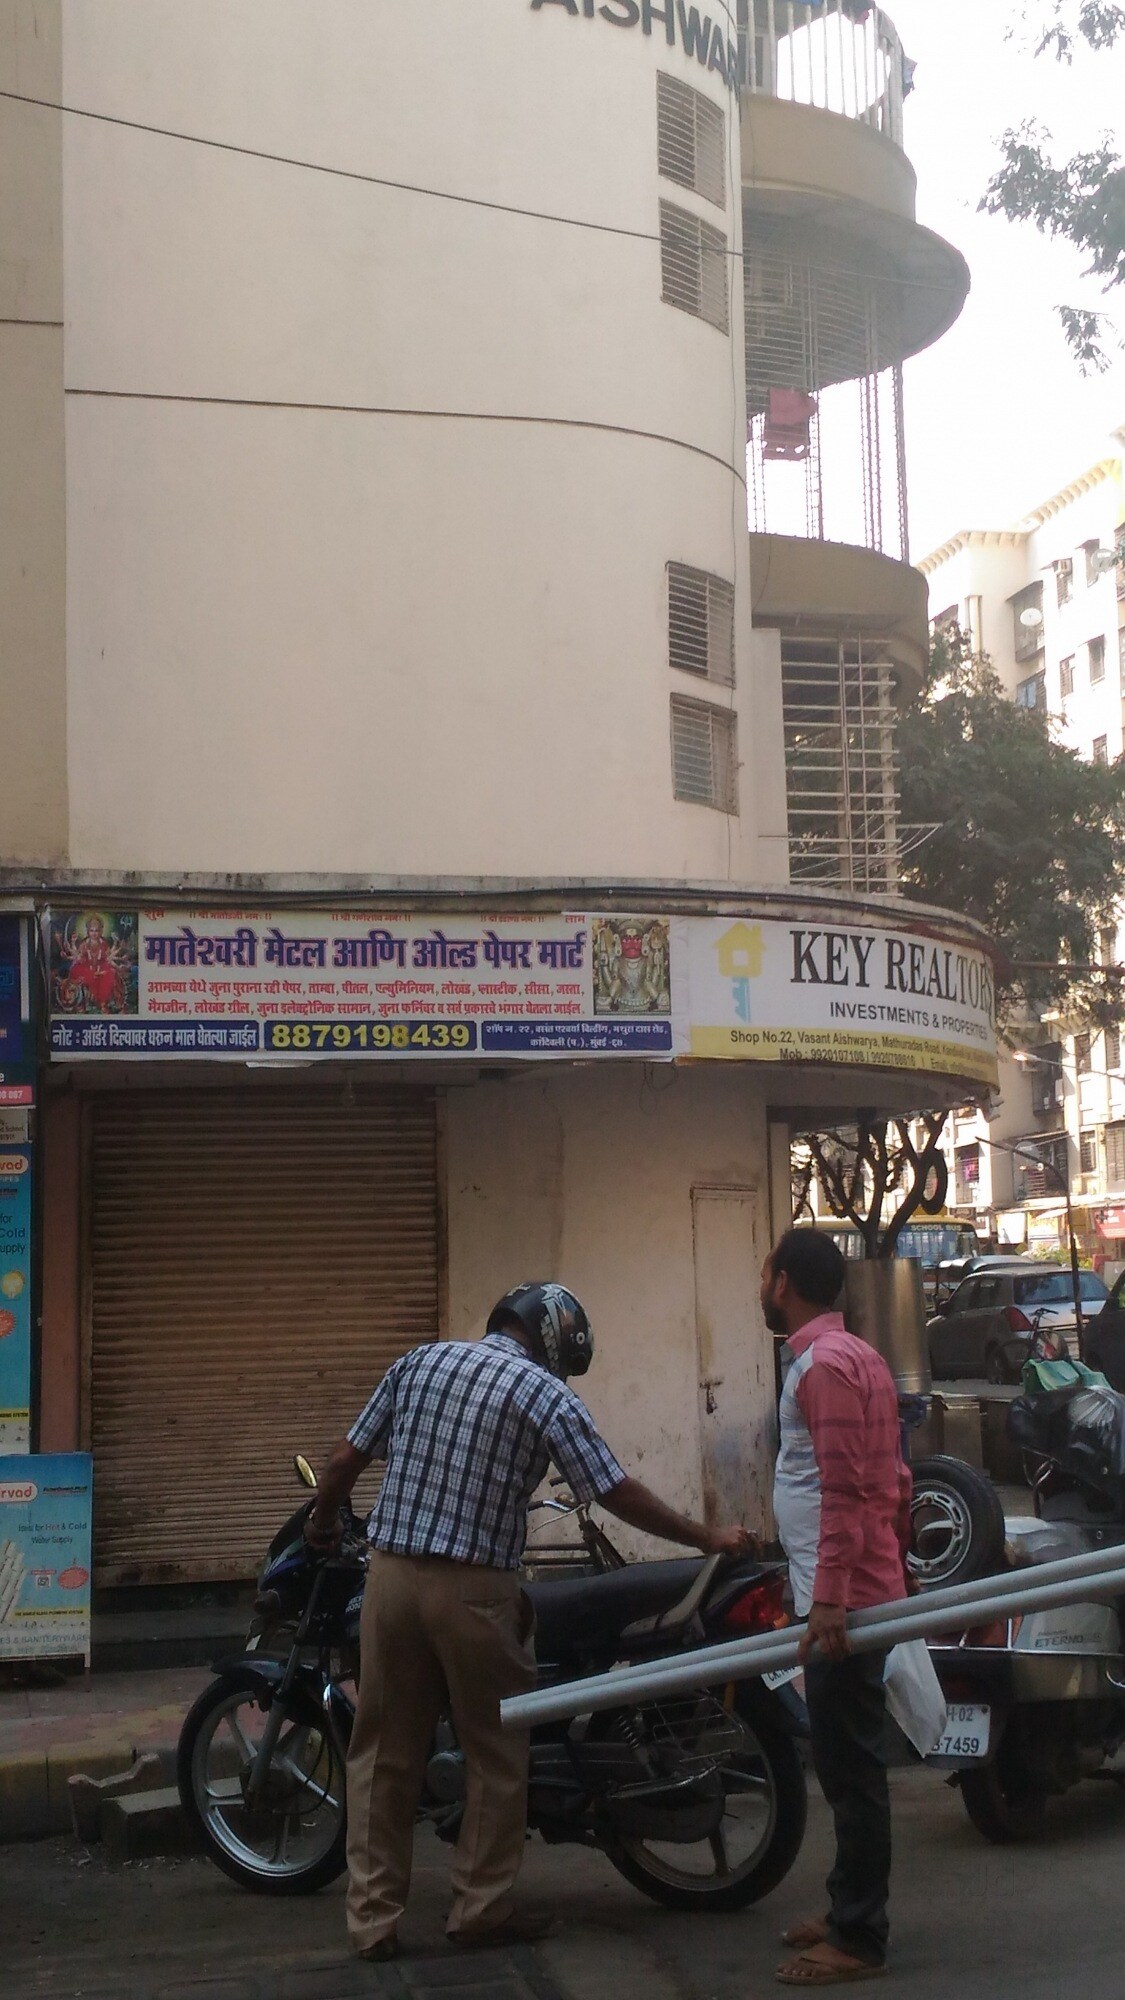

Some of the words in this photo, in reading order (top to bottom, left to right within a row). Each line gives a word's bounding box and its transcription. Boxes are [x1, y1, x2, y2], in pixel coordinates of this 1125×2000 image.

[144, 926, 258, 967] मातेश्वरी
[263, 927, 327, 968] मेटल
[332, 929, 408, 969] आणि
[412, 929, 480, 969] ओल्ड
[482, 930, 533, 970] पेपर
[536, 931, 588, 970] मार्ट
[789, 930, 875, 988] KEY
[830, 1002, 929, 1027] INVESTMENTS
[932, 1014, 939, 1029] &
[272, 1023, 470, 1048] 8879198439
[730, 1030, 760, 1045] Shop
[797, 1032, 831, 1044] Vasant
[0, 1159, 23, 1170] vad
[0, 1243, 25, 1255] upply
[0, 1486, 32, 1499] rvad
[68, 1522, 87, 1530] Cold
[1035, 1634, 1083, 1648] ETERNO
